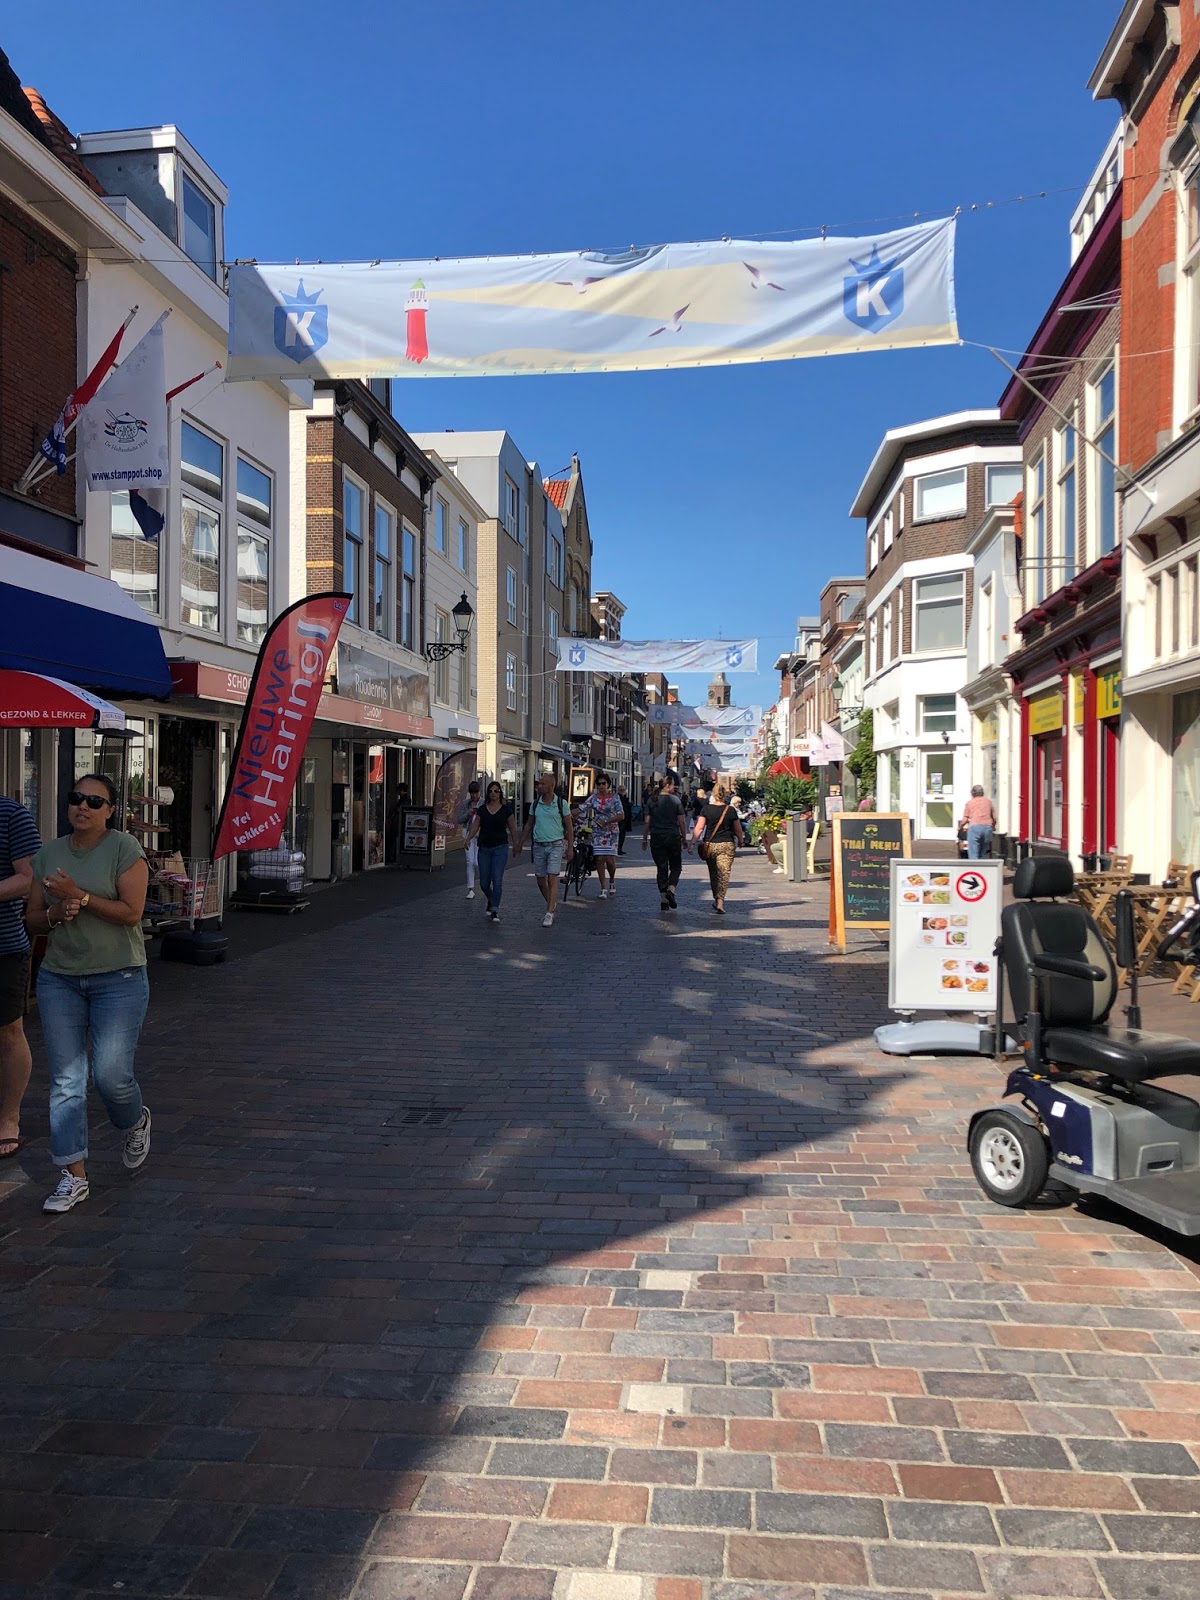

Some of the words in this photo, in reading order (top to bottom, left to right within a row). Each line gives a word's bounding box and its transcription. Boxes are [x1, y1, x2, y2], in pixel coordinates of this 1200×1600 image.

[856, 276, 892, 317] K
[285, 311, 316, 347] K
[91, 467, 163, 481] www.stamppot.shop
[572, 650, 582, 663] K
[728, 651, 740, 664] K
[0, 710, 40, 719] GEZOND
[51, 711, 87, 720] LEKKER
[233, 648, 293, 801] Nieuwe
[253, 641, 325, 808] Haring
[232, 811, 251, 828] Vet
[870, 840, 900, 850] MENU
